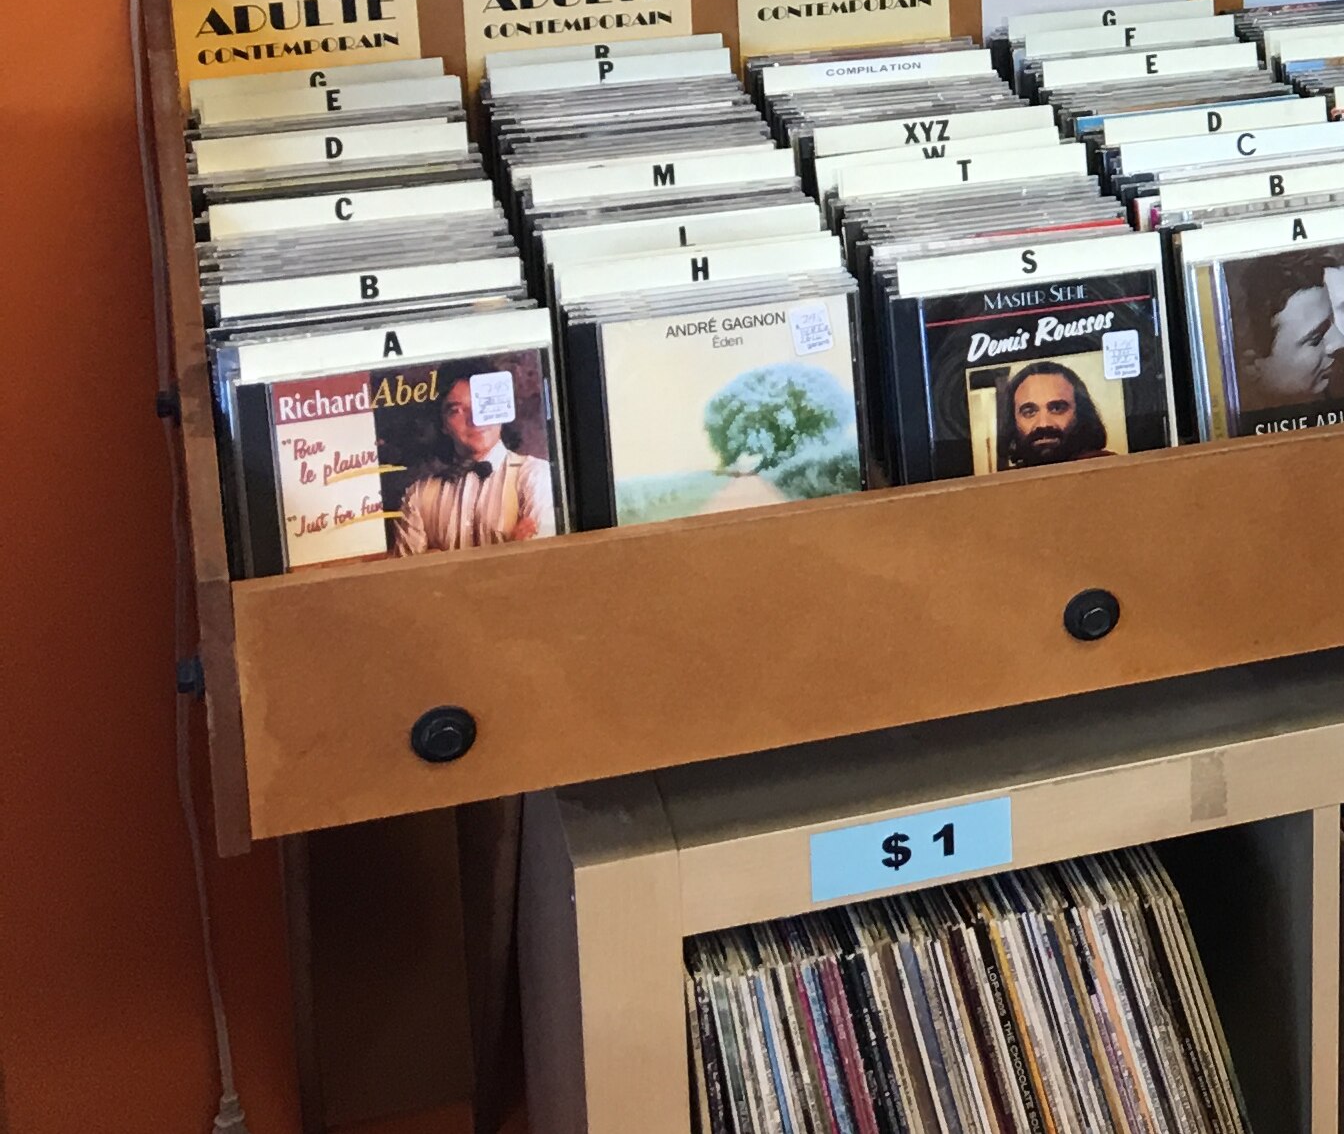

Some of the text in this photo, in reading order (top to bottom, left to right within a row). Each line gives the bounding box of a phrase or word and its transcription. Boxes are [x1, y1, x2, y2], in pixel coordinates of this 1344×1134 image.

[483, 10, 672, 39] CONTEMPORAIN
[197, 31, 399, 65] CONTEMPORAIN
[826, 61, 922, 76] COMPILATION
[326, 90, 342, 111] E
[903, 120, 950, 144] XYZ
[653, 164, 675, 186] M
[957, 159, 972, 181] T
[335, 197, 353, 220] C
[1292, 219, 1308, 240] A
[691, 258, 710, 281] H
[1022, 251, 1038, 273] S
[360, 274, 379, 299] B
[984, 287, 1045, 311] MASTER
[666, 311, 786, 338] ANDRÉ GAGNON
[383, 331, 403, 357] A
[712, 336, 743, 348] Éden
[966, 311, 1114, 363] Demis Roussos
[279, 384, 369, 421] Richard
[371, 370, 439, 409] Abel
[300, 462, 315, 485] le
[881, 823, 957, 871] $ 1
